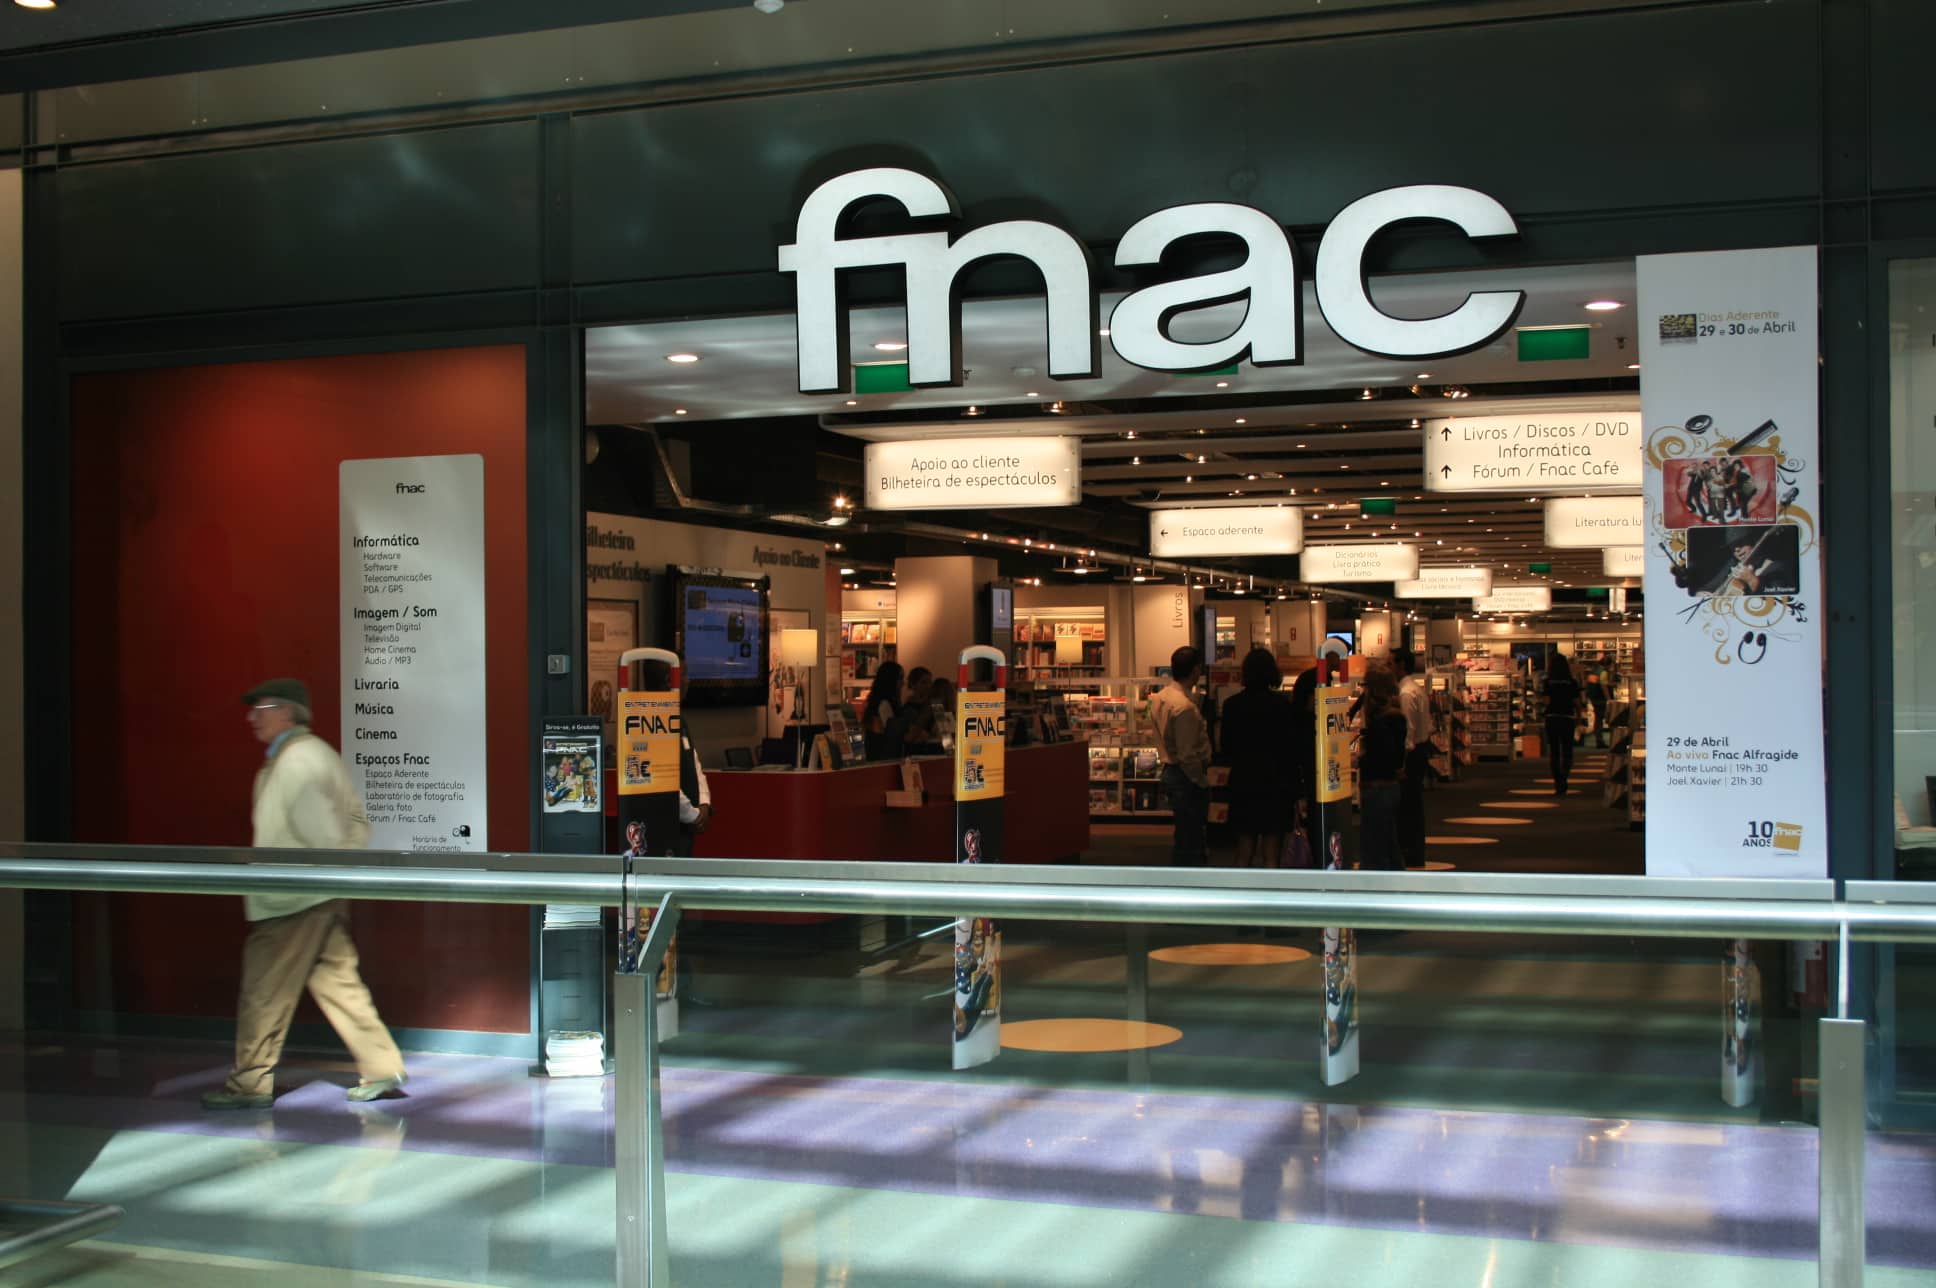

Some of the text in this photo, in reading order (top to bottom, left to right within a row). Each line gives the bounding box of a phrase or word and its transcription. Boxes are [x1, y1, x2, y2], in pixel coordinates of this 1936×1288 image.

[778, 167, 1526, 394] fnac
[1699, 310, 1780, 323] Dias Aderente
[1699, 325, 1715, 337] 29
[1728, 323, 1745, 336] 30
[1747, 327, 1760, 335] de
[1763, 321, 1797, 334] Abril
[1464, 426, 1508, 442] Livros
[1527, 424, 1575, 439] Discos
[1595, 422, 1629, 437] DVD
[1498, 443, 1592, 458] Informática
[911, 455, 1020, 472] Apoio ao cliente
[1473, 464, 1520, 479] Fórum
[1540, 463, 1577, 476] Fnac
[1582, 461, 1620, 475] Café
[881, 472, 1057, 490] Bilheteira de espectáculos
[396, 482, 425, 495] fnac
[1575, 517, 1629, 528] Literatura
[1218, 524, 1265, 537] aderente
[353, 534, 420, 549] Informática
[363, 552, 401, 561] Hardware
[364, 563, 398, 572] Software
[364, 572, 432, 583] Telecomunicações
[363, 585, 379, 594] PDA
[388, 585, 404, 593] GPS
[354, 608, 399, 621] Imagem
[413, 607, 437, 617] Som
[1173, 591, 1184, 628] Livros
[364, 623, 421, 633] Imagem Digital
[364, 634, 399, 643] Televisão
[364, 645, 416, 654] Home Cinema
[395, 656, 411, 664] MP3
[354, 678, 400, 690] Livraria
[355, 702, 394, 715] Música
[625, 714, 680, 735] FNAC
[964, 716, 1006, 738] FNAC
[355, 727, 397, 740] Cinema
[1667, 736, 1729, 747] 29 de Abril
[355, 753, 430, 767] Espaços Fnac
[1667, 749, 1799, 762] Ao vivo Fnac Alfragide
[394, 769, 429, 778] Aderente
[1667, 764, 1697, 773] Monte
[1736, 764, 1752, 773] 19h
[1755, 764, 1768, 773] 30
[365, 780, 465, 791] Bilheteira de espectáculos
[1667, 776, 1687, 786] Joel
[1690, 776, 1722, 786] Xavier
[1731, 777, 1747, 786] 21h
[1750, 777, 1762, 786] 30
[366, 792, 464, 802] Laboratório de fotografia
[366, 803, 413, 811] Galeria foto
[398, 814, 416, 823] Fnac
[418, 813, 437, 823] Café
[1748, 820, 1774, 838] 10
[1742, 839, 1772, 848] ANOS
